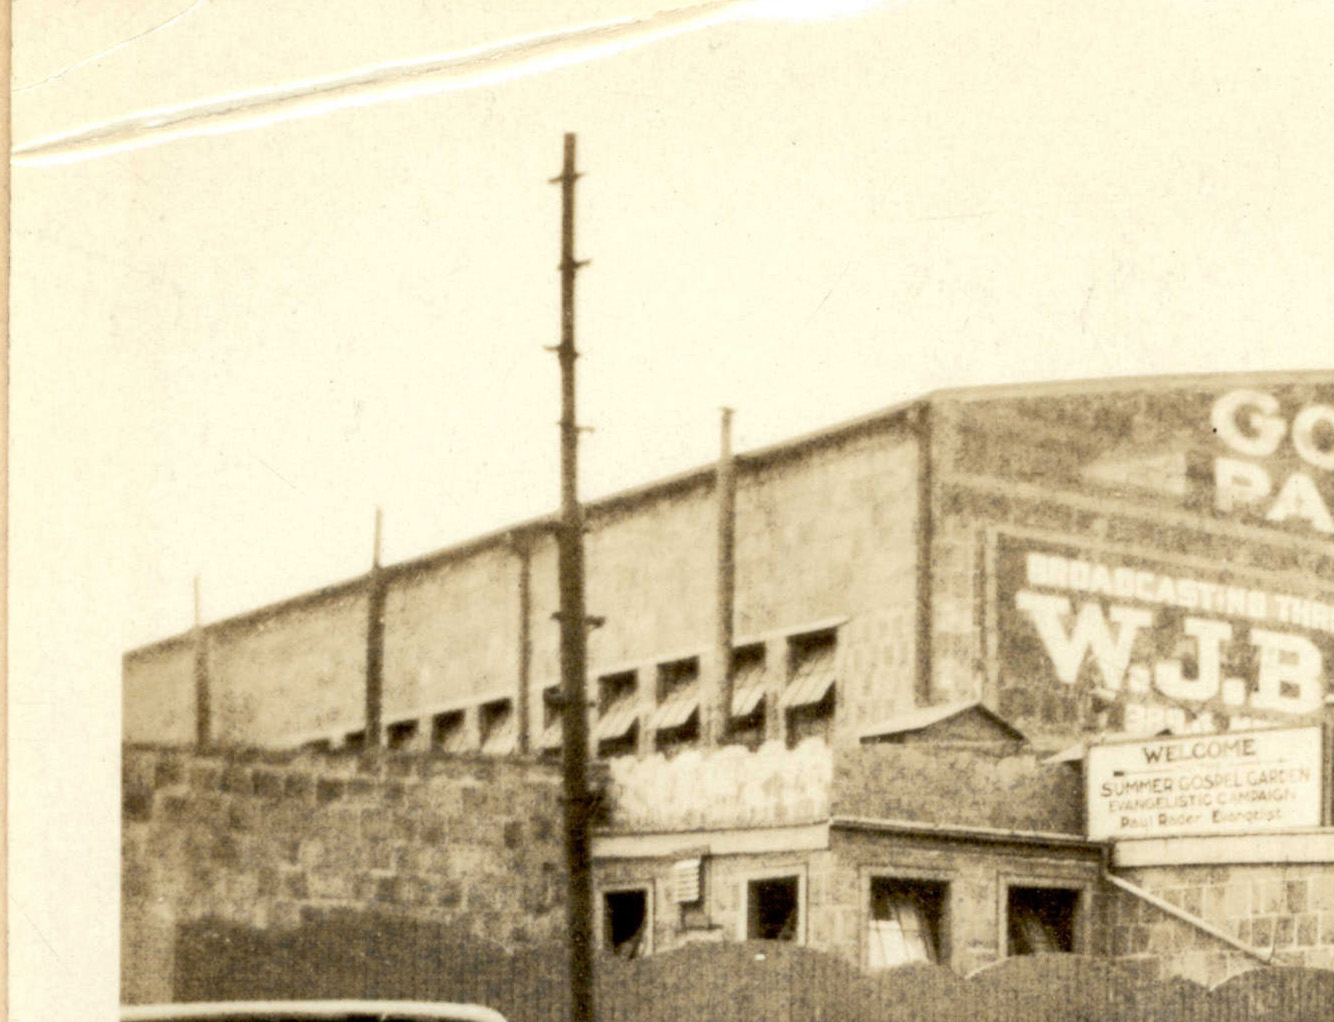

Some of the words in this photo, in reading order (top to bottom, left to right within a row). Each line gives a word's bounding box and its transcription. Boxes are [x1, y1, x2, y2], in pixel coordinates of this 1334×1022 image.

[1142, 738, 1257, 764] WELCOME
[1100, 777, 1174, 798] SUMMER
[1177, 772, 1244, 792] GOSPEL
[1246, 767, 1311, 787] GARDEN
[1108, 793, 1213, 813] EVANGELISTIC
